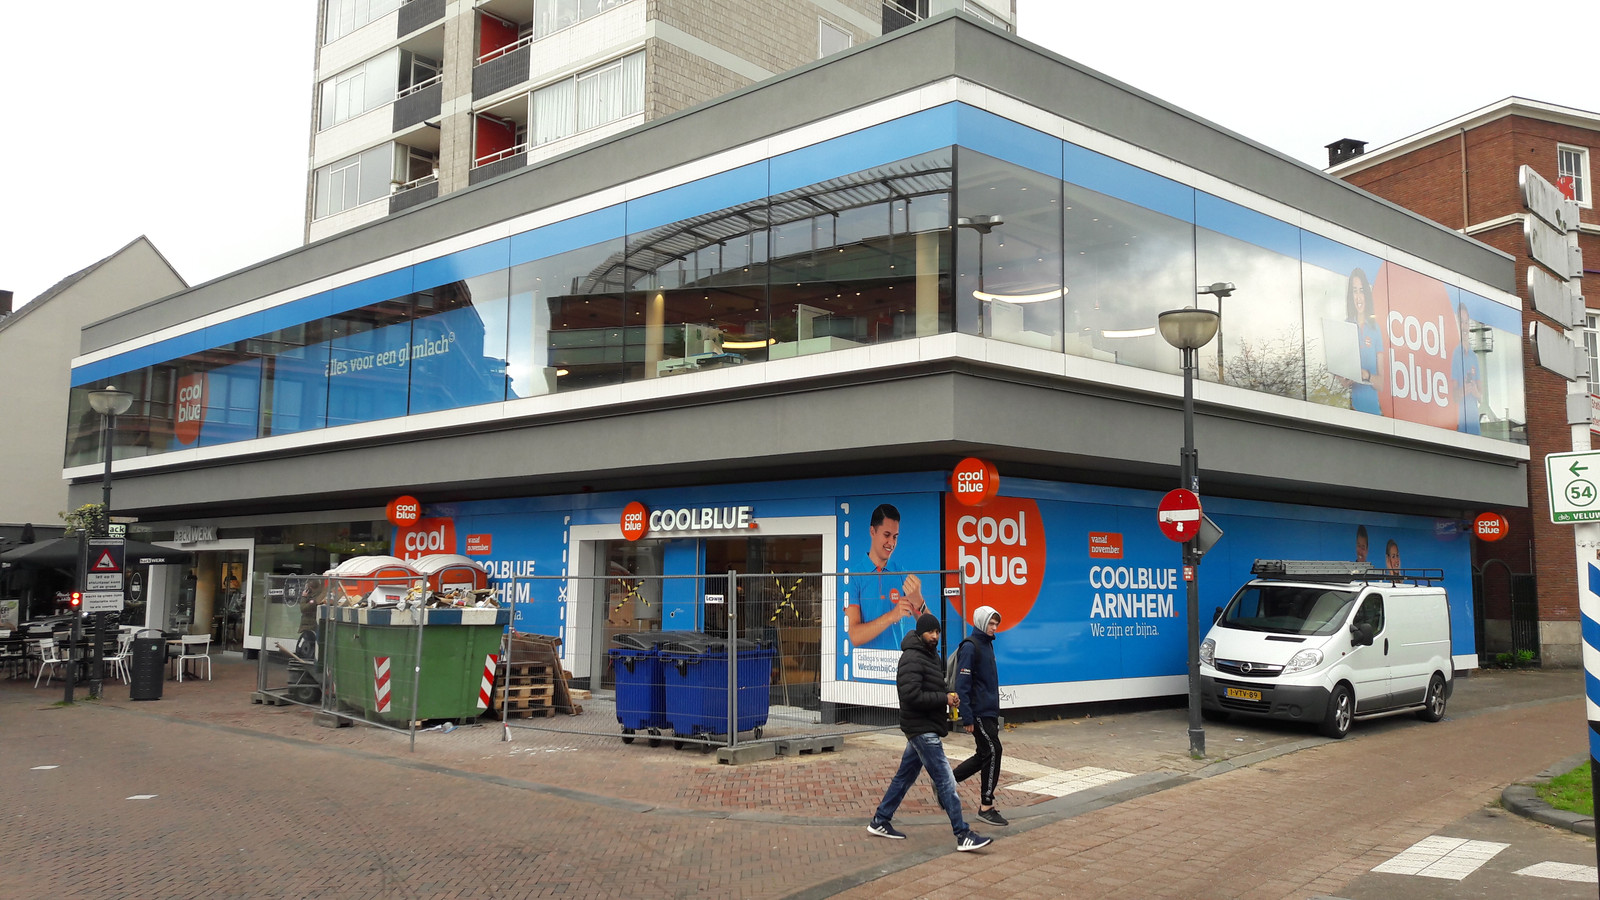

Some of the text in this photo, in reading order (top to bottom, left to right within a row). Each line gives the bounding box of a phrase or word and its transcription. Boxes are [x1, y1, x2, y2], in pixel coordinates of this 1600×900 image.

[1386, 310, 1447, 359] cool
[324, 358, 348, 377] alles
[350, 354, 374, 372] voor
[376, 350, 396, 366] een
[1389, 348, 1449, 408] blue
[180, 379, 202, 402] cool
[178, 402, 201, 422] blue
[958, 469, 983, 481] cool
[958, 481, 984, 492] blue
[1571, 486, 1593, 499] 54
[396, 504, 417, 512] cool
[396, 511, 416, 519] blue
[625, 511, 642, 521] cool
[624, 521, 642, 531] blue
[957, 510, 1027, 546] cool
[1478, 519, 1500, 527] cool
[1478, 526, 1500, 534] blue
[405, 525, 445, 551] cool
[1091, 535, 1108, 543] vanaf
[1091, 545, 1120, 554] november
[958, 545, 1028, 586] blue
[1089, 565, 1178, 590] COOLBLUE
[1090, 622, 1160, 640] We zijn er bijna.
